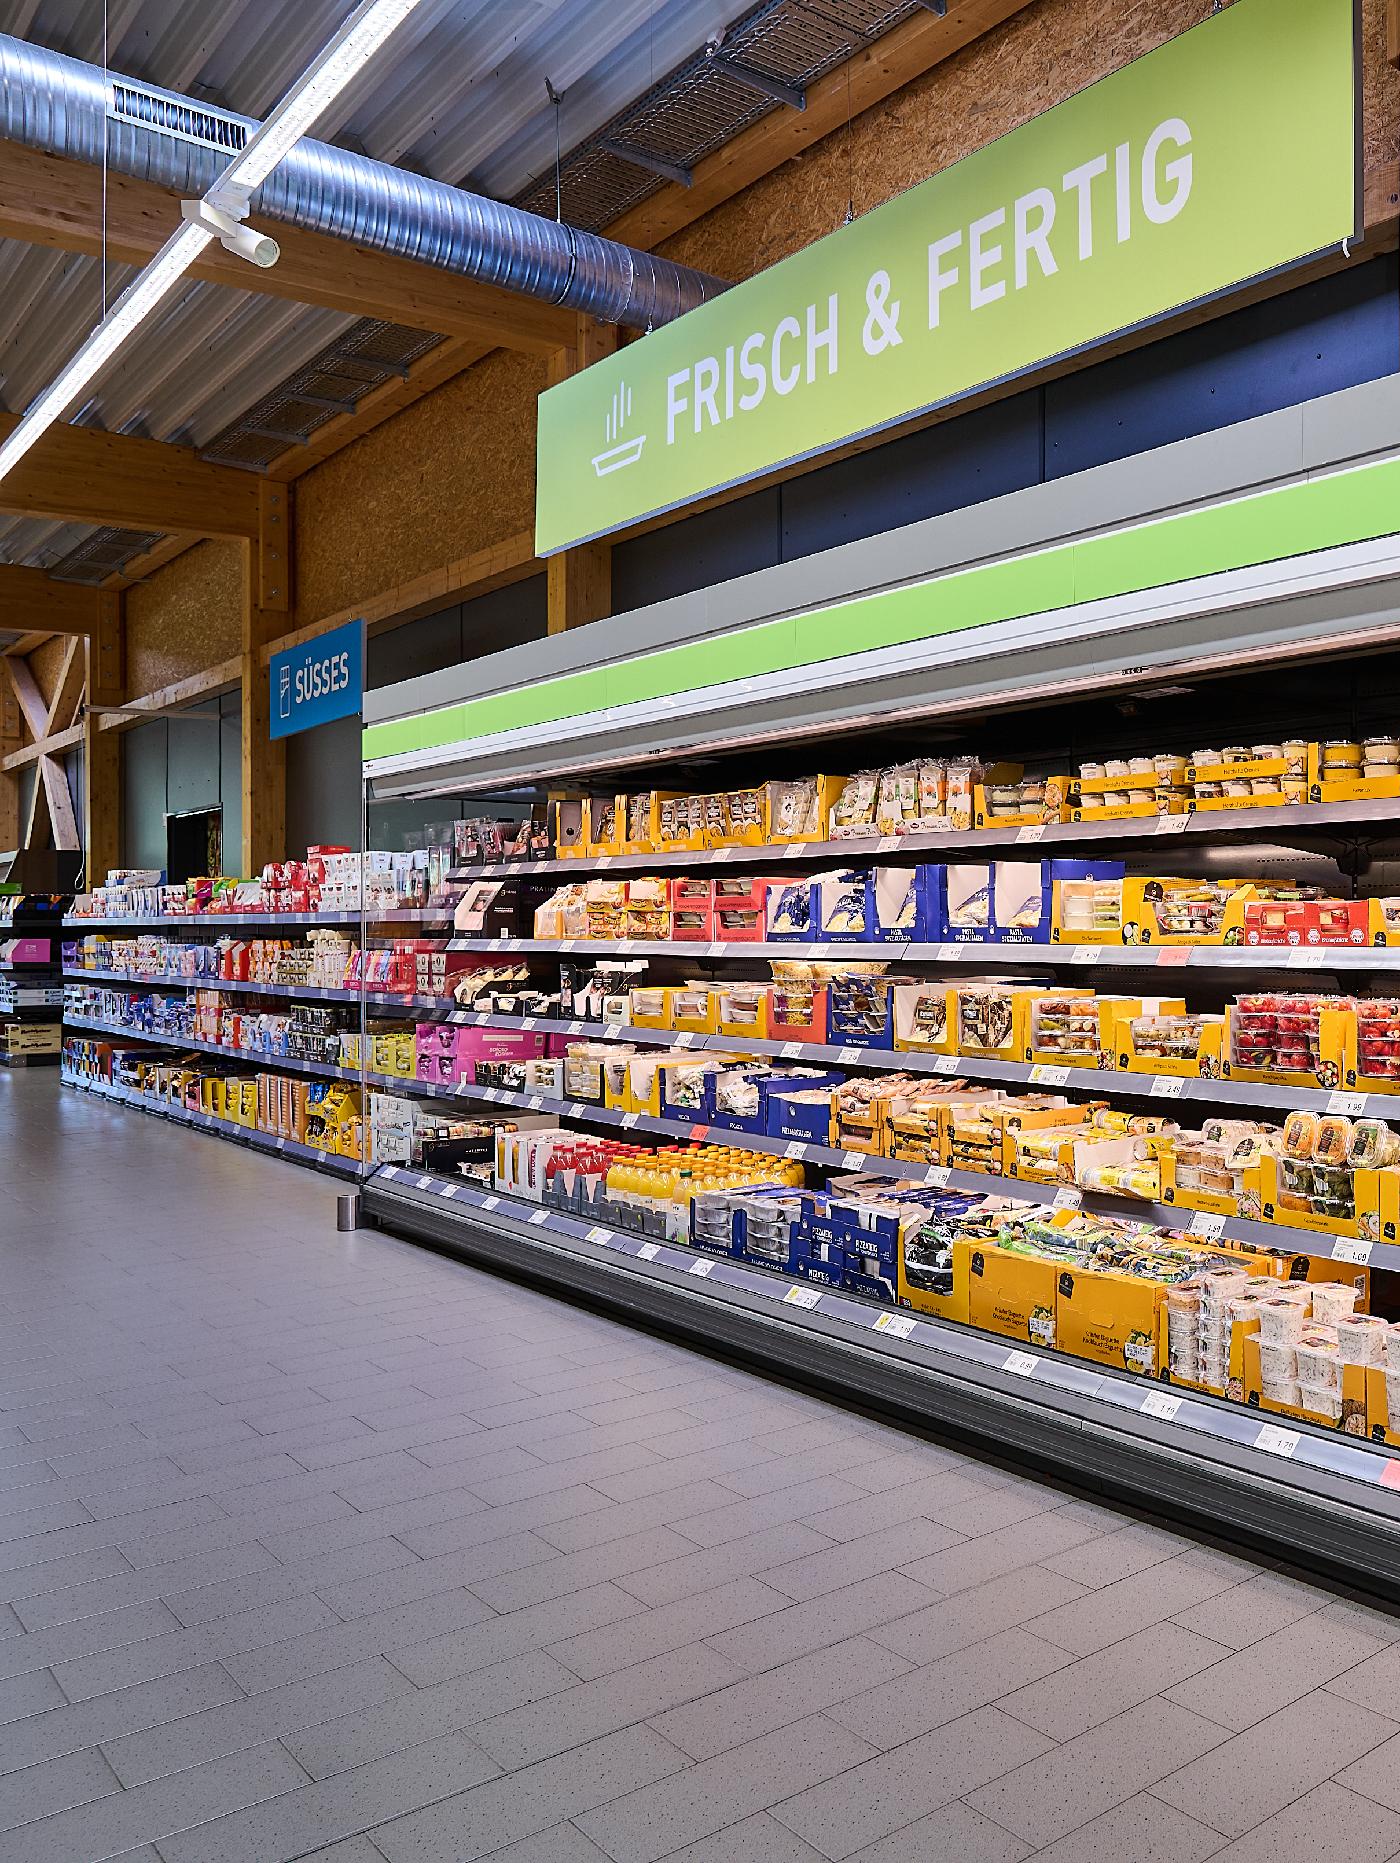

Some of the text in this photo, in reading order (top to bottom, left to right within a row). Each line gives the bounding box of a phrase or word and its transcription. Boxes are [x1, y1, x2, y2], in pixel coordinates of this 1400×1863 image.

[666, 117, 1194, 446] FRISCH & FERTIG
[295, 652, 349, 704] SÜSSES
